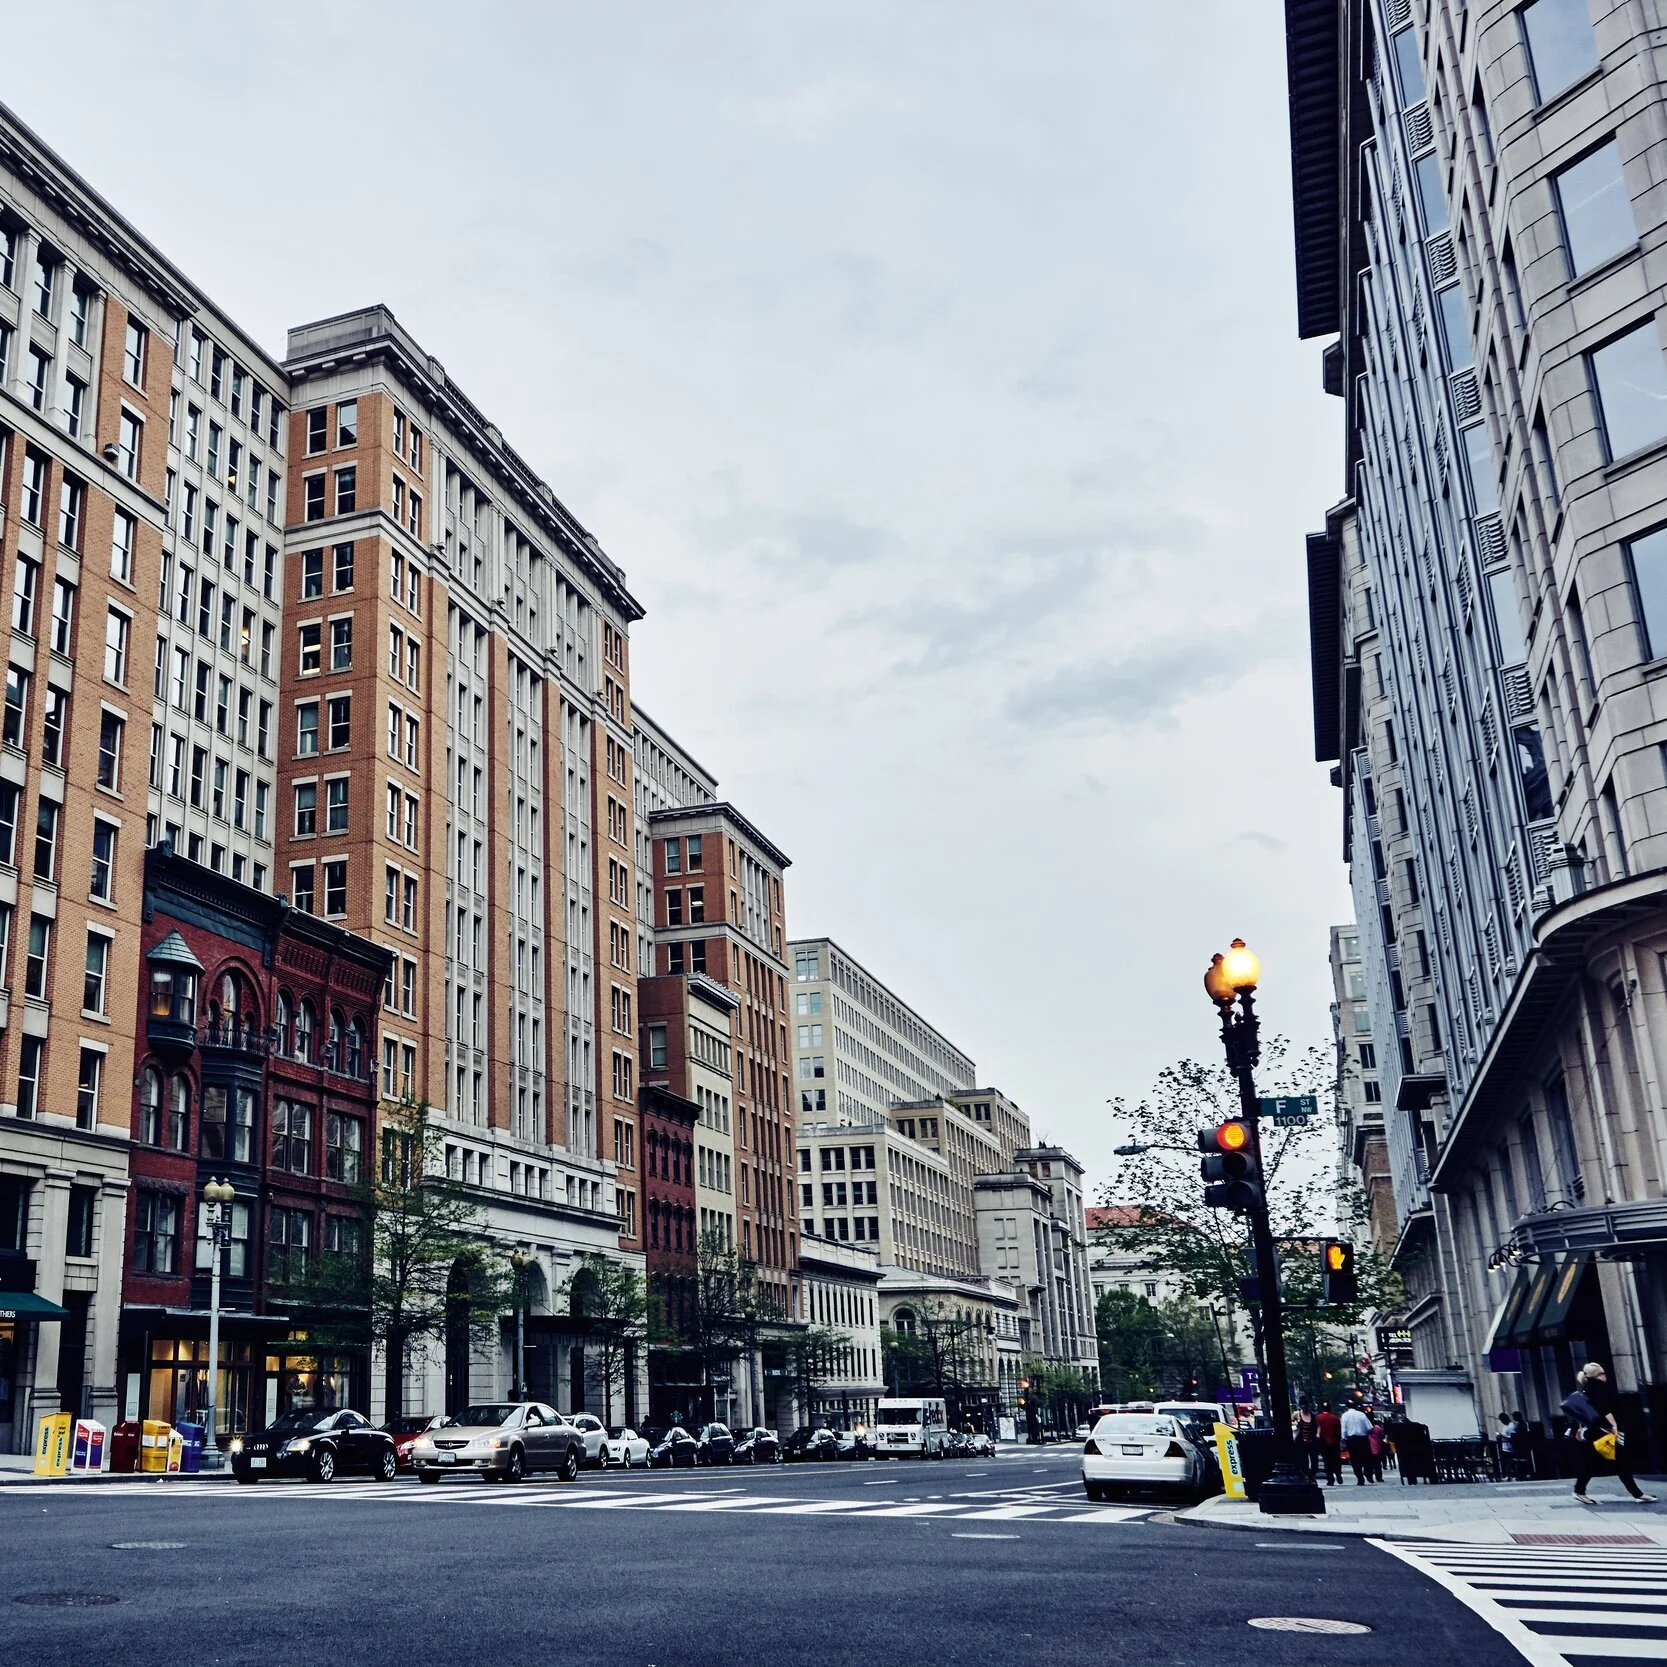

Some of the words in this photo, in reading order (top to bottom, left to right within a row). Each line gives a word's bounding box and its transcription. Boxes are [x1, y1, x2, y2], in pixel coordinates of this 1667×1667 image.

[1276, 1100, 1286, 1113] F
[1300, 1098, 1310, 1106] ST
[1275, 1115, 1306, 1126] 1100
[1226, 1439, 1239, 1475] express
